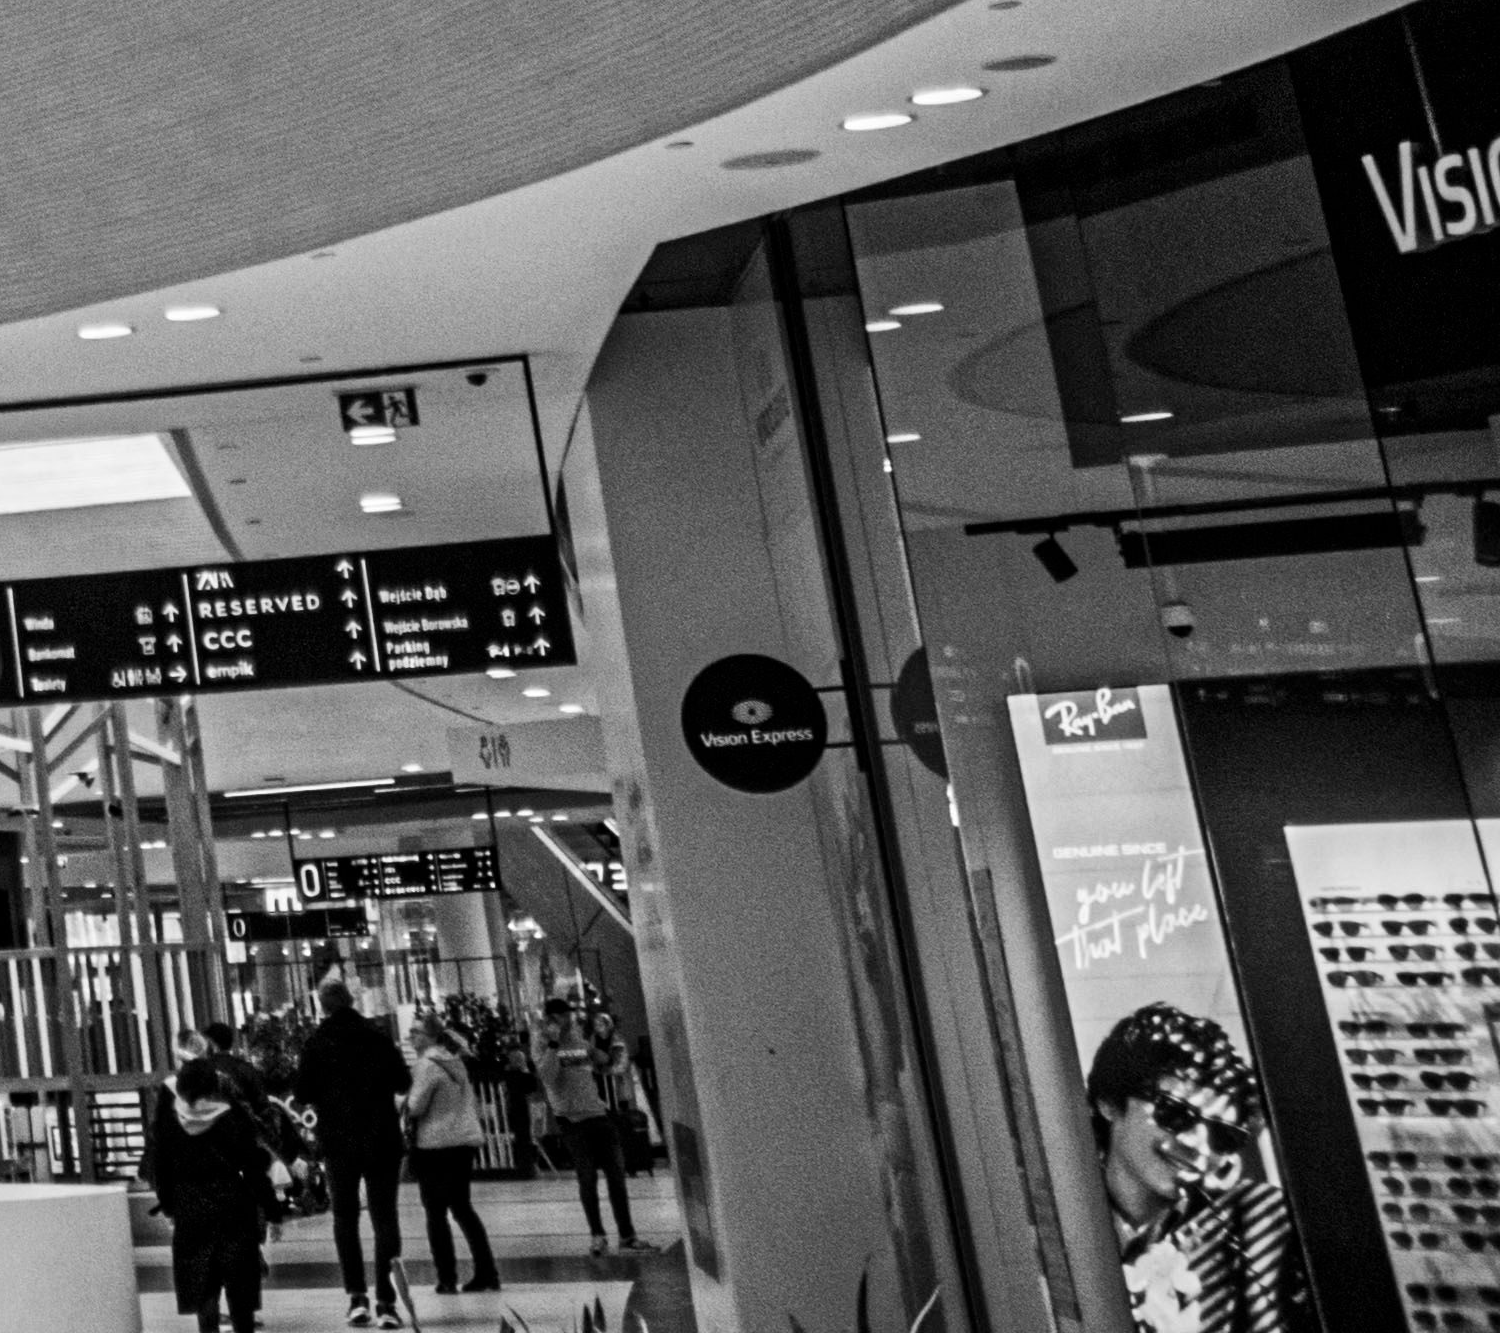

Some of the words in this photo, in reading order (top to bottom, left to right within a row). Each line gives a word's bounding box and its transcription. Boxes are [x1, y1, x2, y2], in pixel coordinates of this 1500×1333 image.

[198, 593, 321, 619] RESERVED
[203, 629, 253, 650] CCC
[1044, 687, 1136, 736] Ray-Ban
[750, 729, 814, 746] Express
[1052, 844, 1120, 859] GENUINE
[1120, 842, 1167, 856] SINCE
